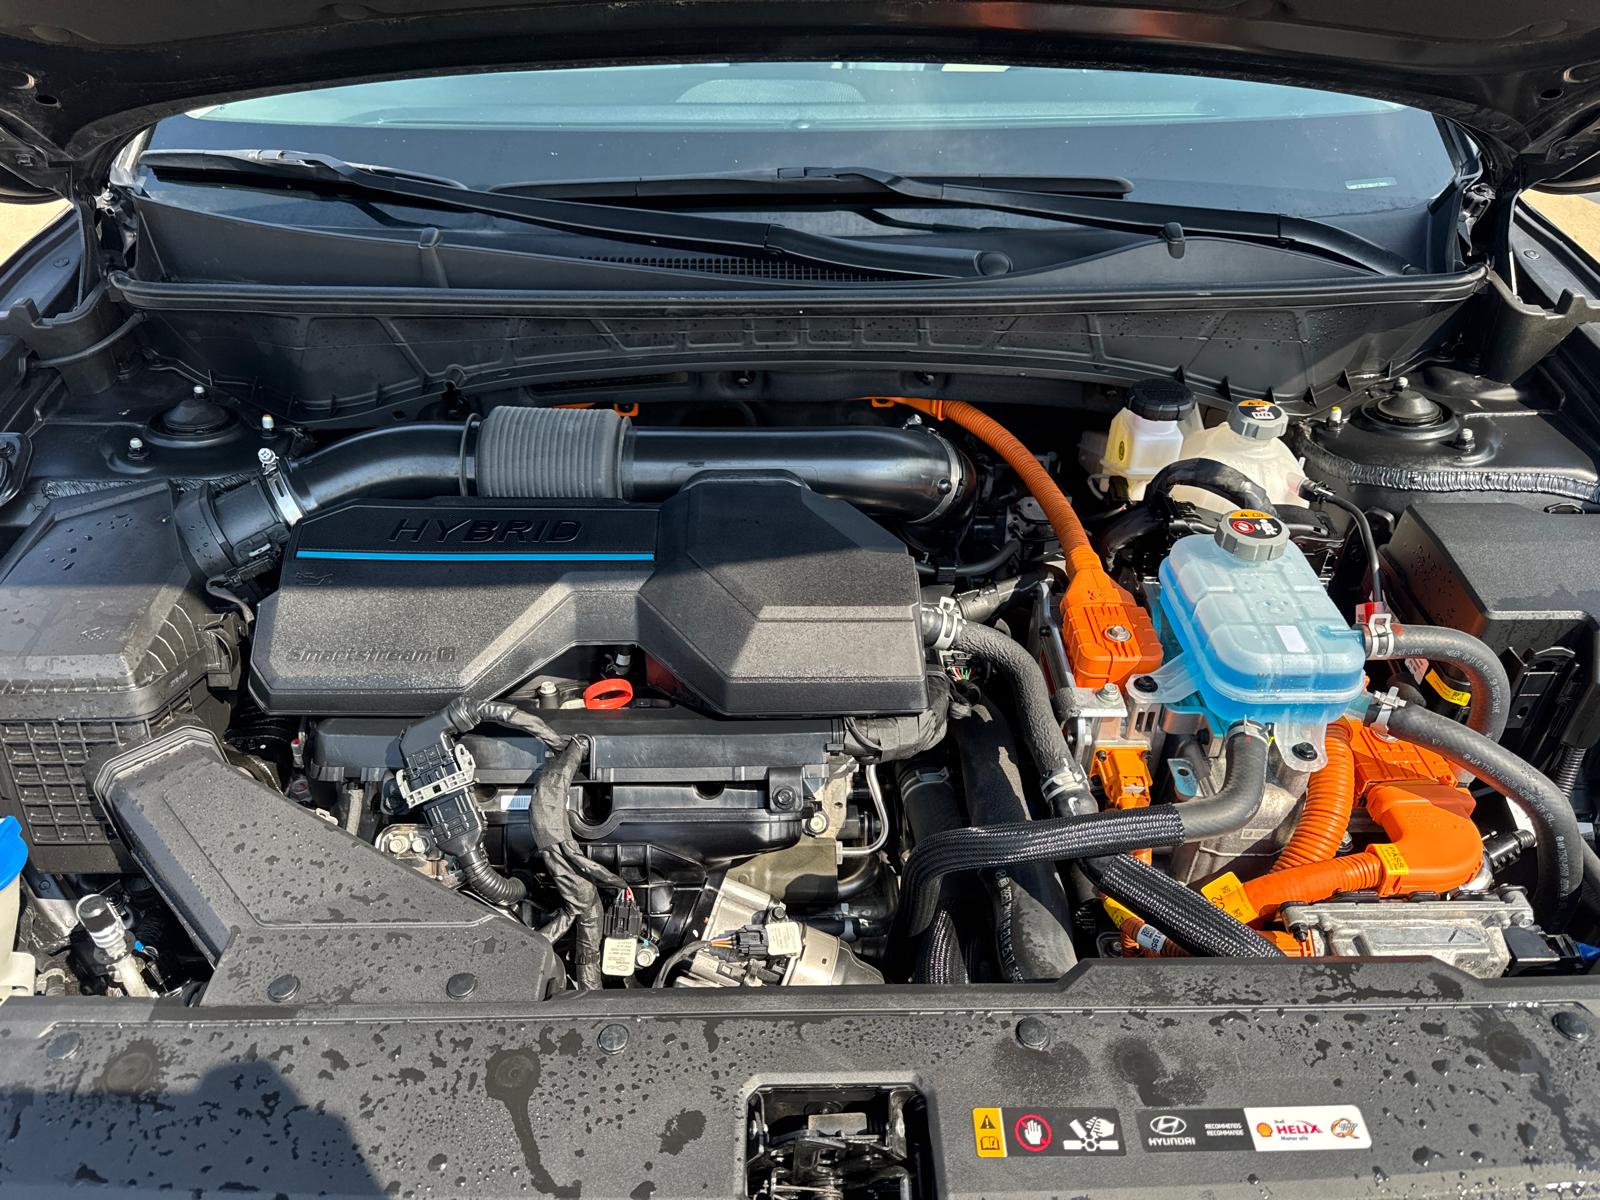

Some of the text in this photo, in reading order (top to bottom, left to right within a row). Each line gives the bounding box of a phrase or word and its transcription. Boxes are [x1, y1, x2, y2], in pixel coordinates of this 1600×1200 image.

[387, 517, 584, 543] HYBRID
[288, 646, 434, 664] Smartstream
[1256, 672, 1280, 680] MAX
[1253, 682, 1277, 690] MIN
[1388, 847, 1405, 868] PASS
[1204, 1122, 1243, 1131] RECOMMENDS
[1276, 1123, 1322, 1135] HELIX
[1206, 1129, 1245, 1137] RECOMMANDE
[1148, 1136, 1197, 1147] HYUNDAI
